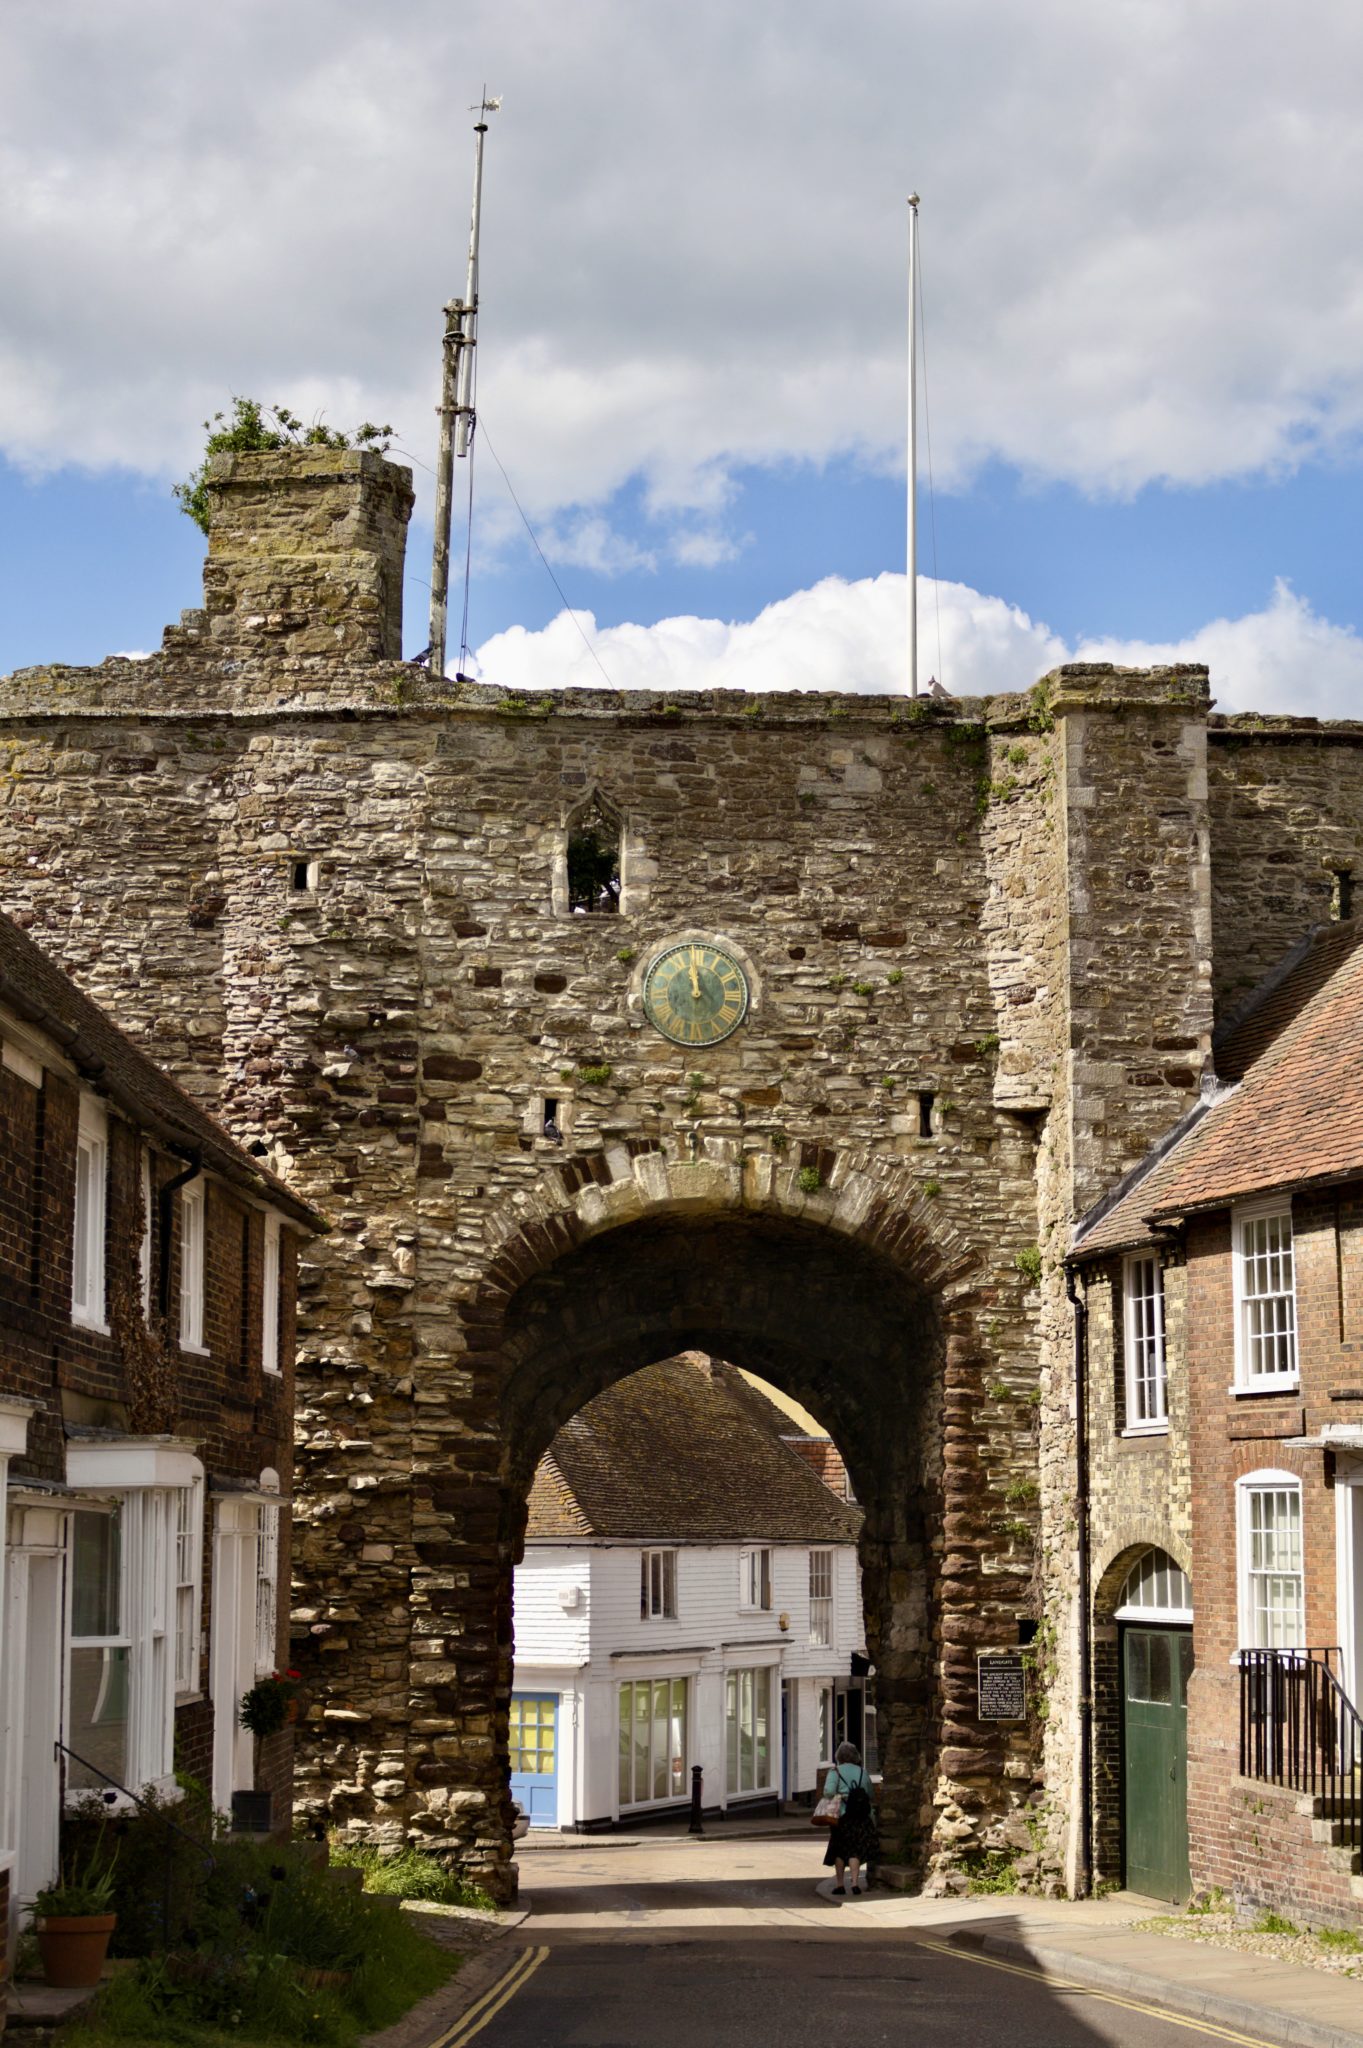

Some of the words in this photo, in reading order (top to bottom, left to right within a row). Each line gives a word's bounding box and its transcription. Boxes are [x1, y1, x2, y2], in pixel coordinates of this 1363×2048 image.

[710, 955, 721, 970] I
[720, 970, 736, 984] II
[725, 990, 741, 1002] III
[719, 1005, 737, 1024] IIII
[690, 1023, 702, 1041] VI
[711, 1019, 723, 1036] V
